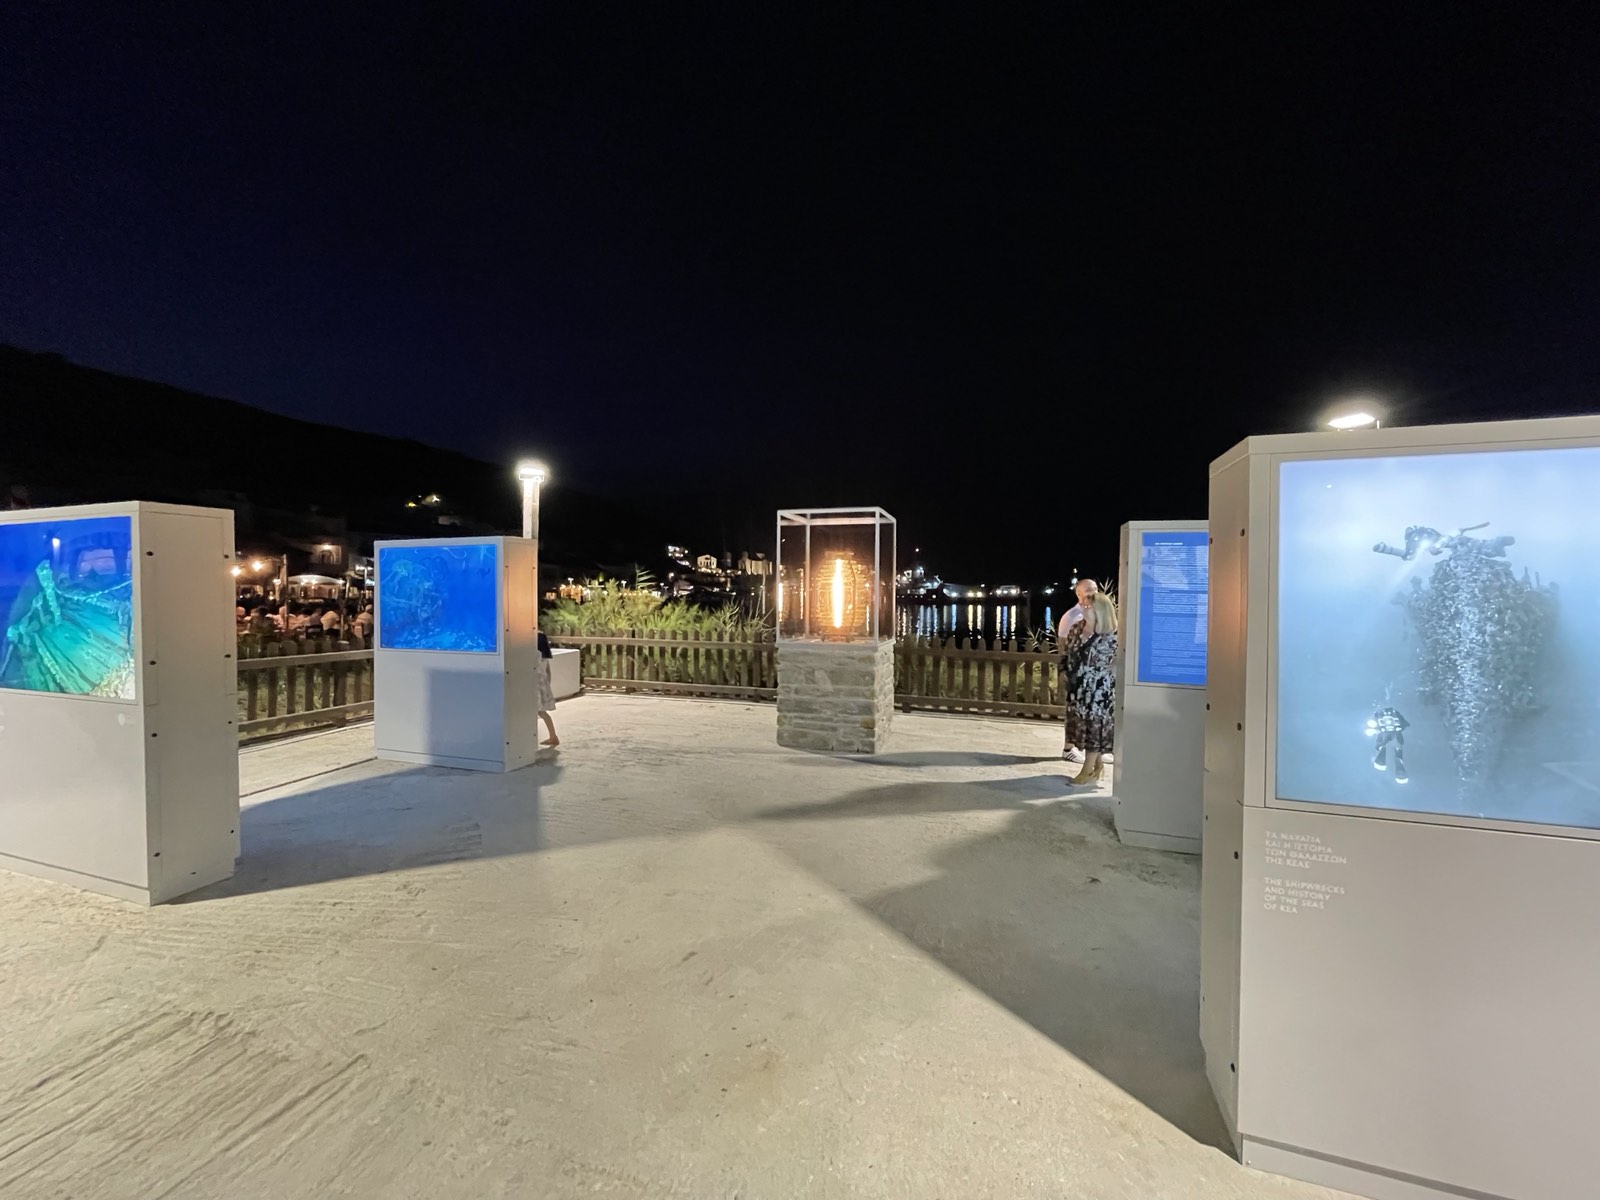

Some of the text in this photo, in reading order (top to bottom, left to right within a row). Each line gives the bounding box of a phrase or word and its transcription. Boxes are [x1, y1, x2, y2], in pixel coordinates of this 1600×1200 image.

[1265, 831, 1277, 839] ΤΑ
[1265, 839, 1280, 847] ΚΑΙ
[1294, 843, 1332, 853] ΙΣΤΟΡΙΑ
[1265, 856, 1283, 865] ΤΗΣ
[1264, 877, 1344, 894] THE SHIPWRECKS
[1264, 886, 1330, 900] AND HISTORY
[1264, 894, 1324, 909] OF THE SEAS
[1280, 905, 1298, 914] KEA
